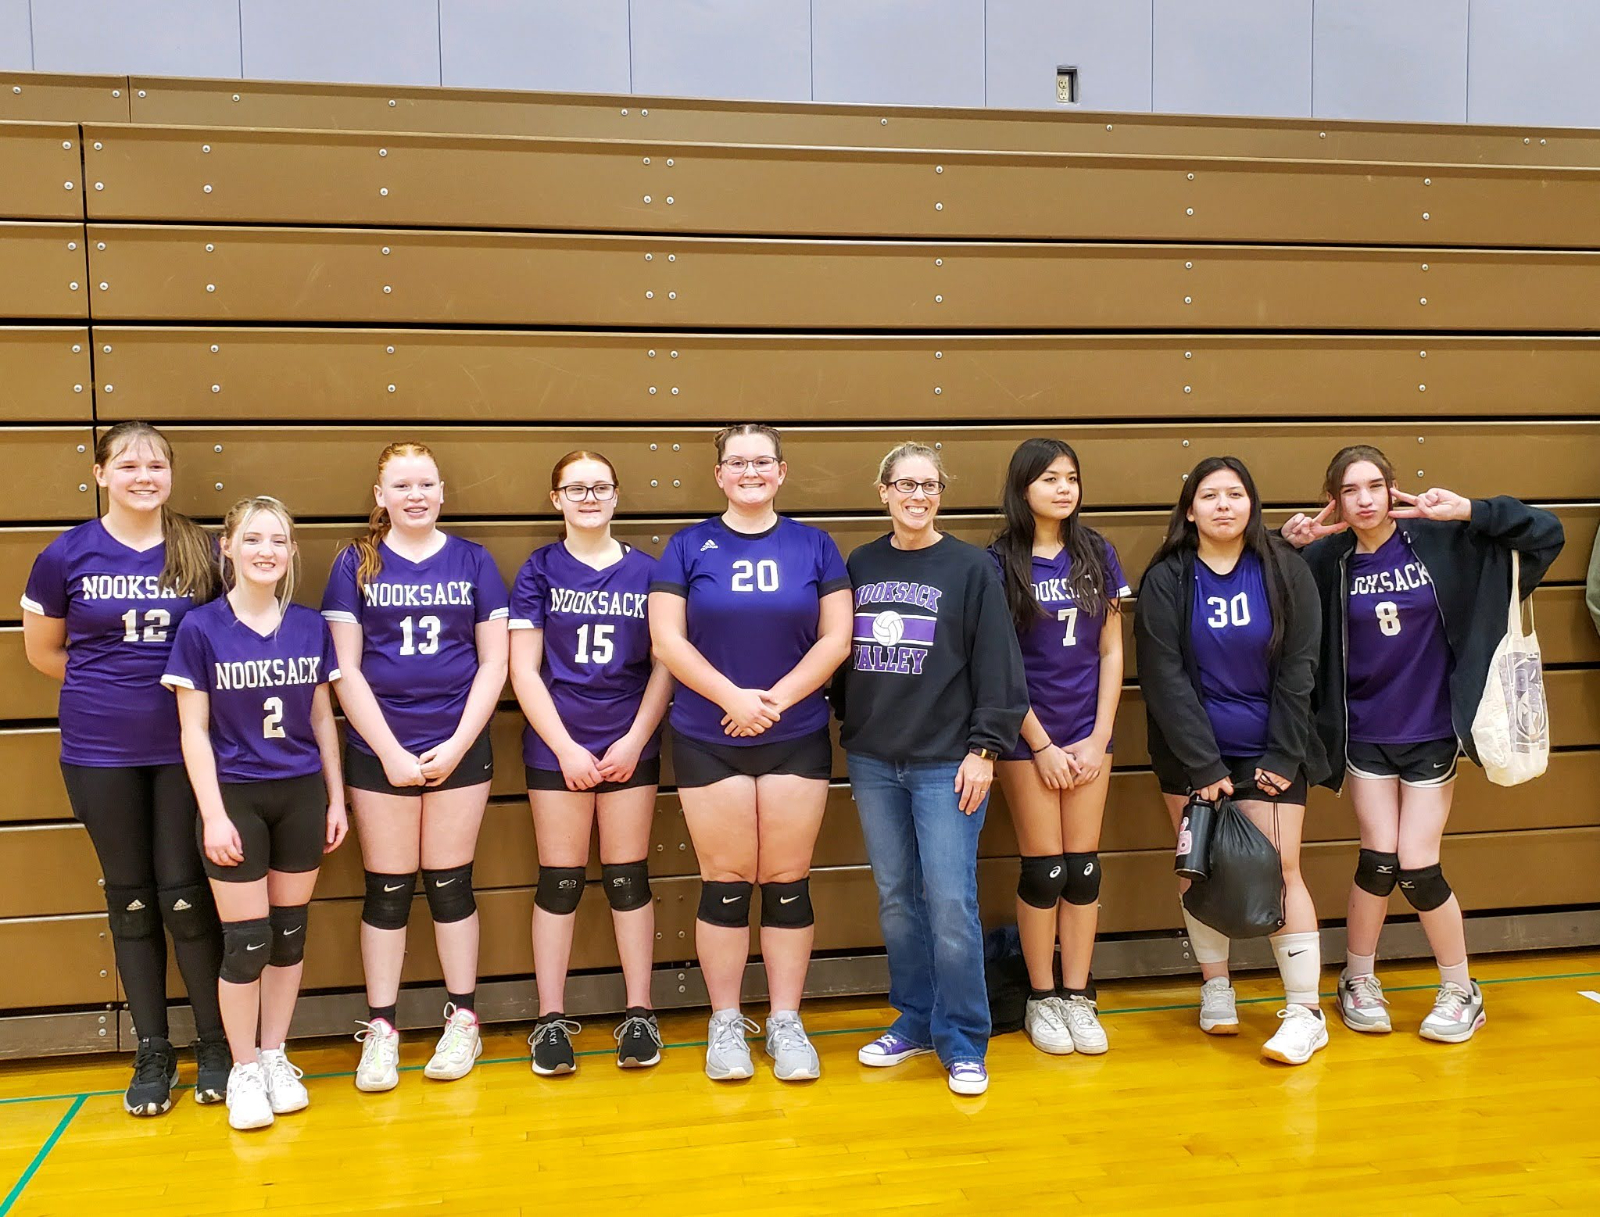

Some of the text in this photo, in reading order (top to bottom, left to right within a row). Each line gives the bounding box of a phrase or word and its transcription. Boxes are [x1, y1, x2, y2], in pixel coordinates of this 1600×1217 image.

[81, 574, 195, 600] NOOKSA
[731, 559, 779, 592] 20
[363, 581, 472, 607] NOOKSACK
[550, 587, 647, 619] NOOKSACK
[1207, 591, 1251, 629] 30
[121, 608, 171, 642] 12
[399, 615, 441, 656] 13
[1057, 607, 1078, 647] 7
[1375, 601, 1401, 636] 8
[574, 624, 615, 664] 15
[215, 656, 321, 690] NOOKSACK
[263, 696, 286, 739] 2
